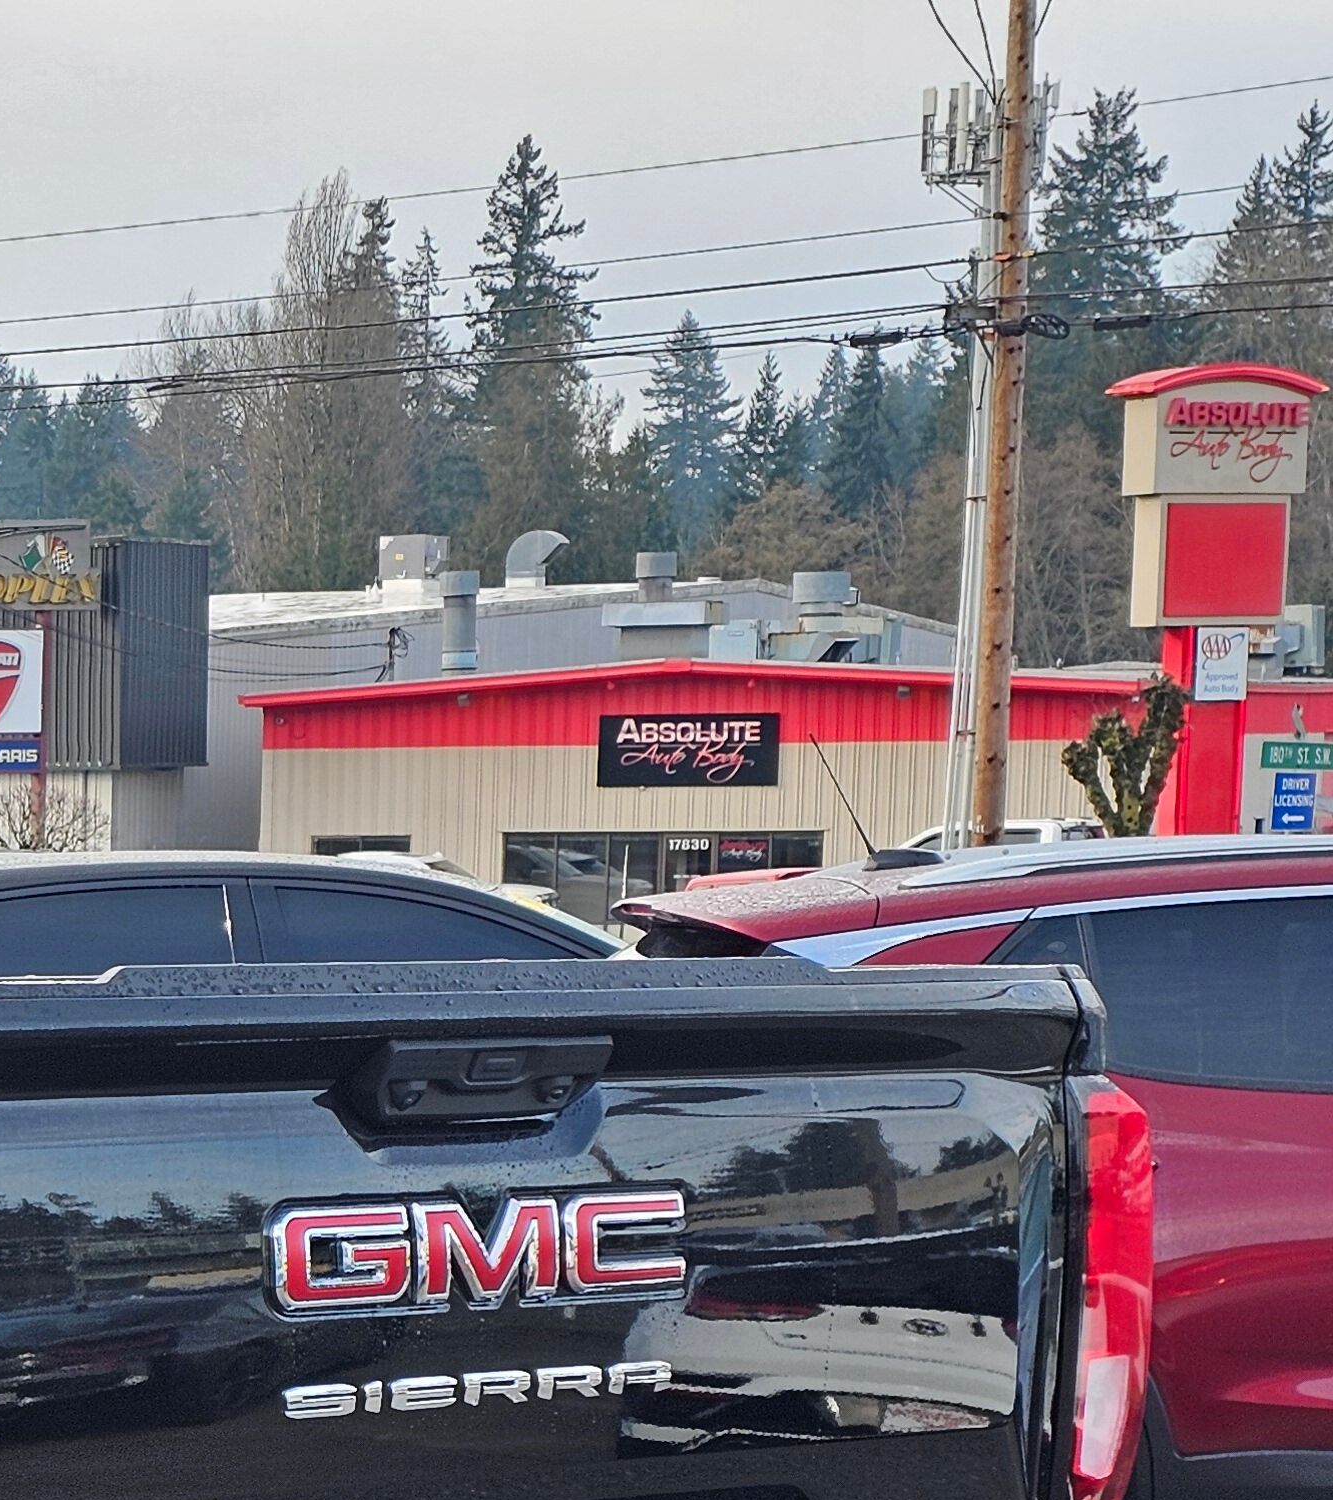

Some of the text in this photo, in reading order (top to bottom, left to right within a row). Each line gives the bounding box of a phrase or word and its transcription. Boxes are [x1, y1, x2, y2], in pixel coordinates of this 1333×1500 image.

[1165, 398, 1310, 427] ABSOLUTE
[1171, 425, 1293, 483] Auto Body
[1204, 634, 1229, 659] AAA
[616, 718, 761, 743] ABSOLUTE
[621, 738, 755, 783] Auto Body
[1281, 778, 1310, 791] DRIVER
[1274, 795, 1314, 806] LICENSING
[669, 838, 710, 850] 17830
[268, 1188, 687, 1318] GMC
[281, 1360, 673, 1420] SIERRA
